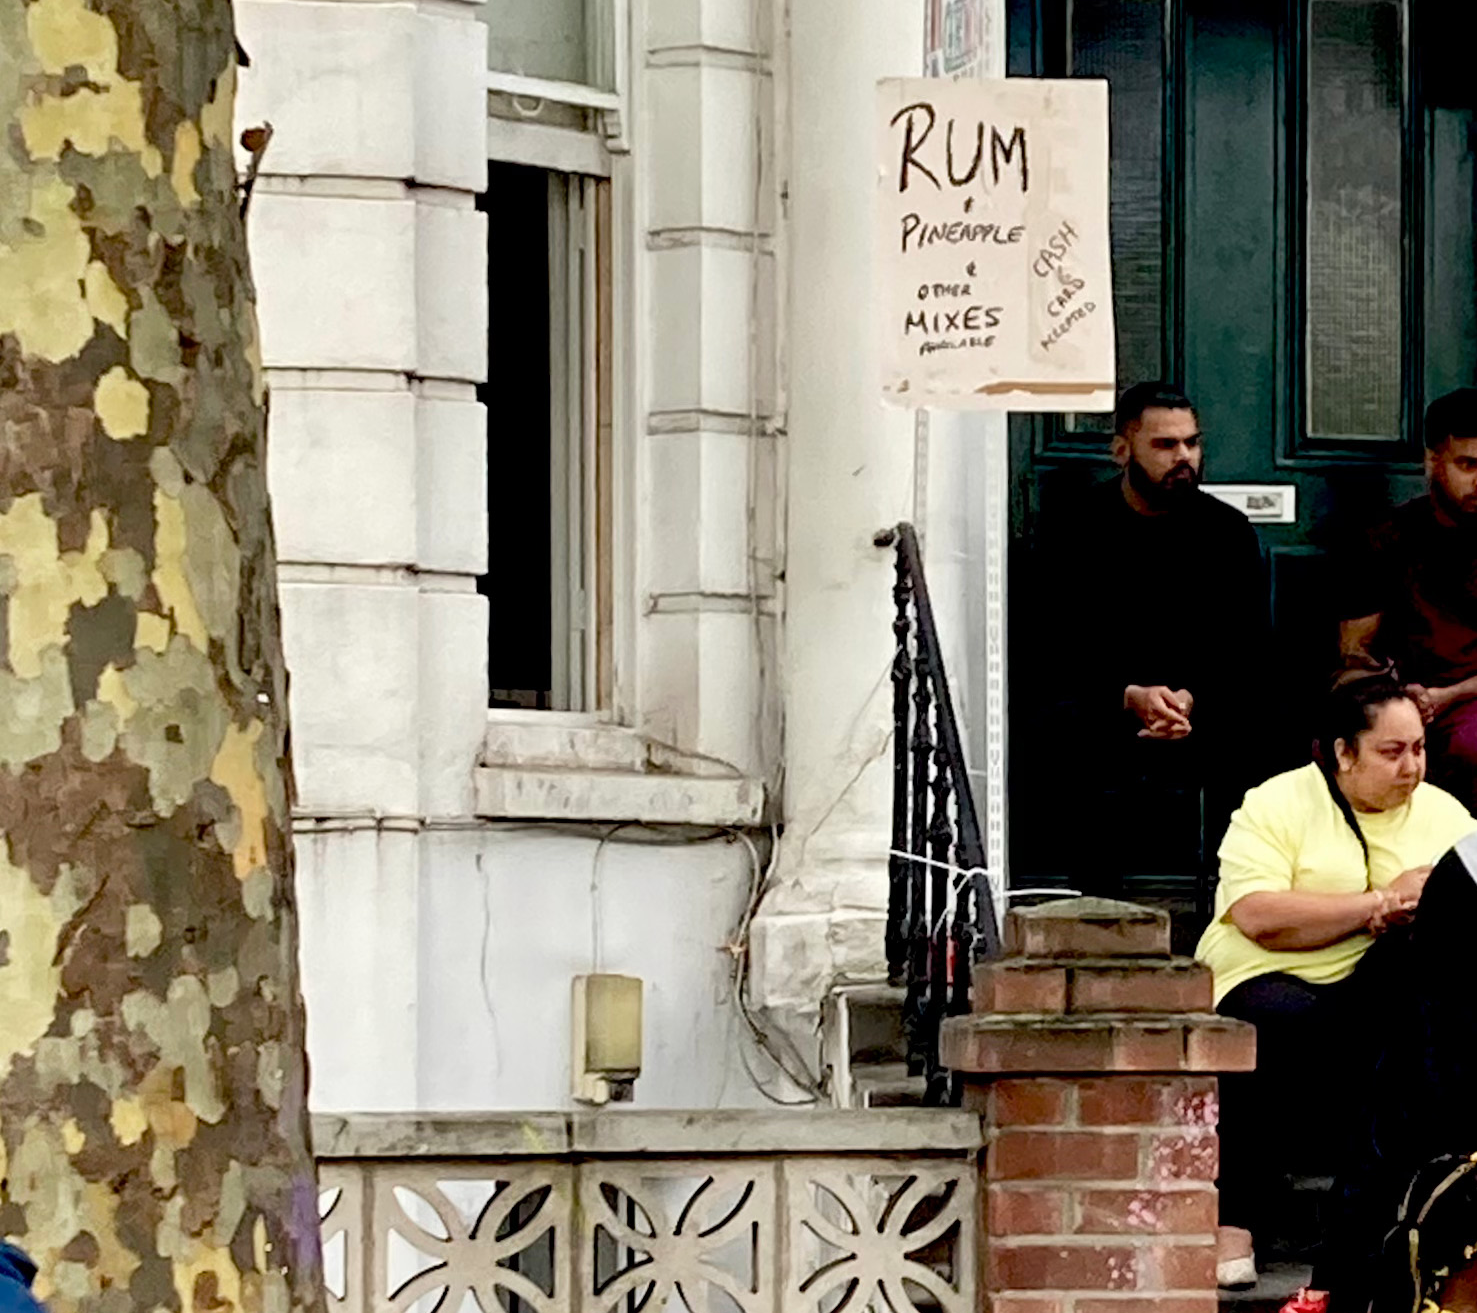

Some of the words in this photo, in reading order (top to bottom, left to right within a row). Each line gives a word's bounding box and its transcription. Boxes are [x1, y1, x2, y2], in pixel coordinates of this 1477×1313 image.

[889, 101, 1029, 194] RUM
[901, 212, 1027, 253] PINEAPPLE
[1033, 220, 1079, 278] CASH
[917, 283, 972, 300] OTHER
[1047, 278, 1086, 317] CARD
[904, 305, 1004, 335] MIXES
